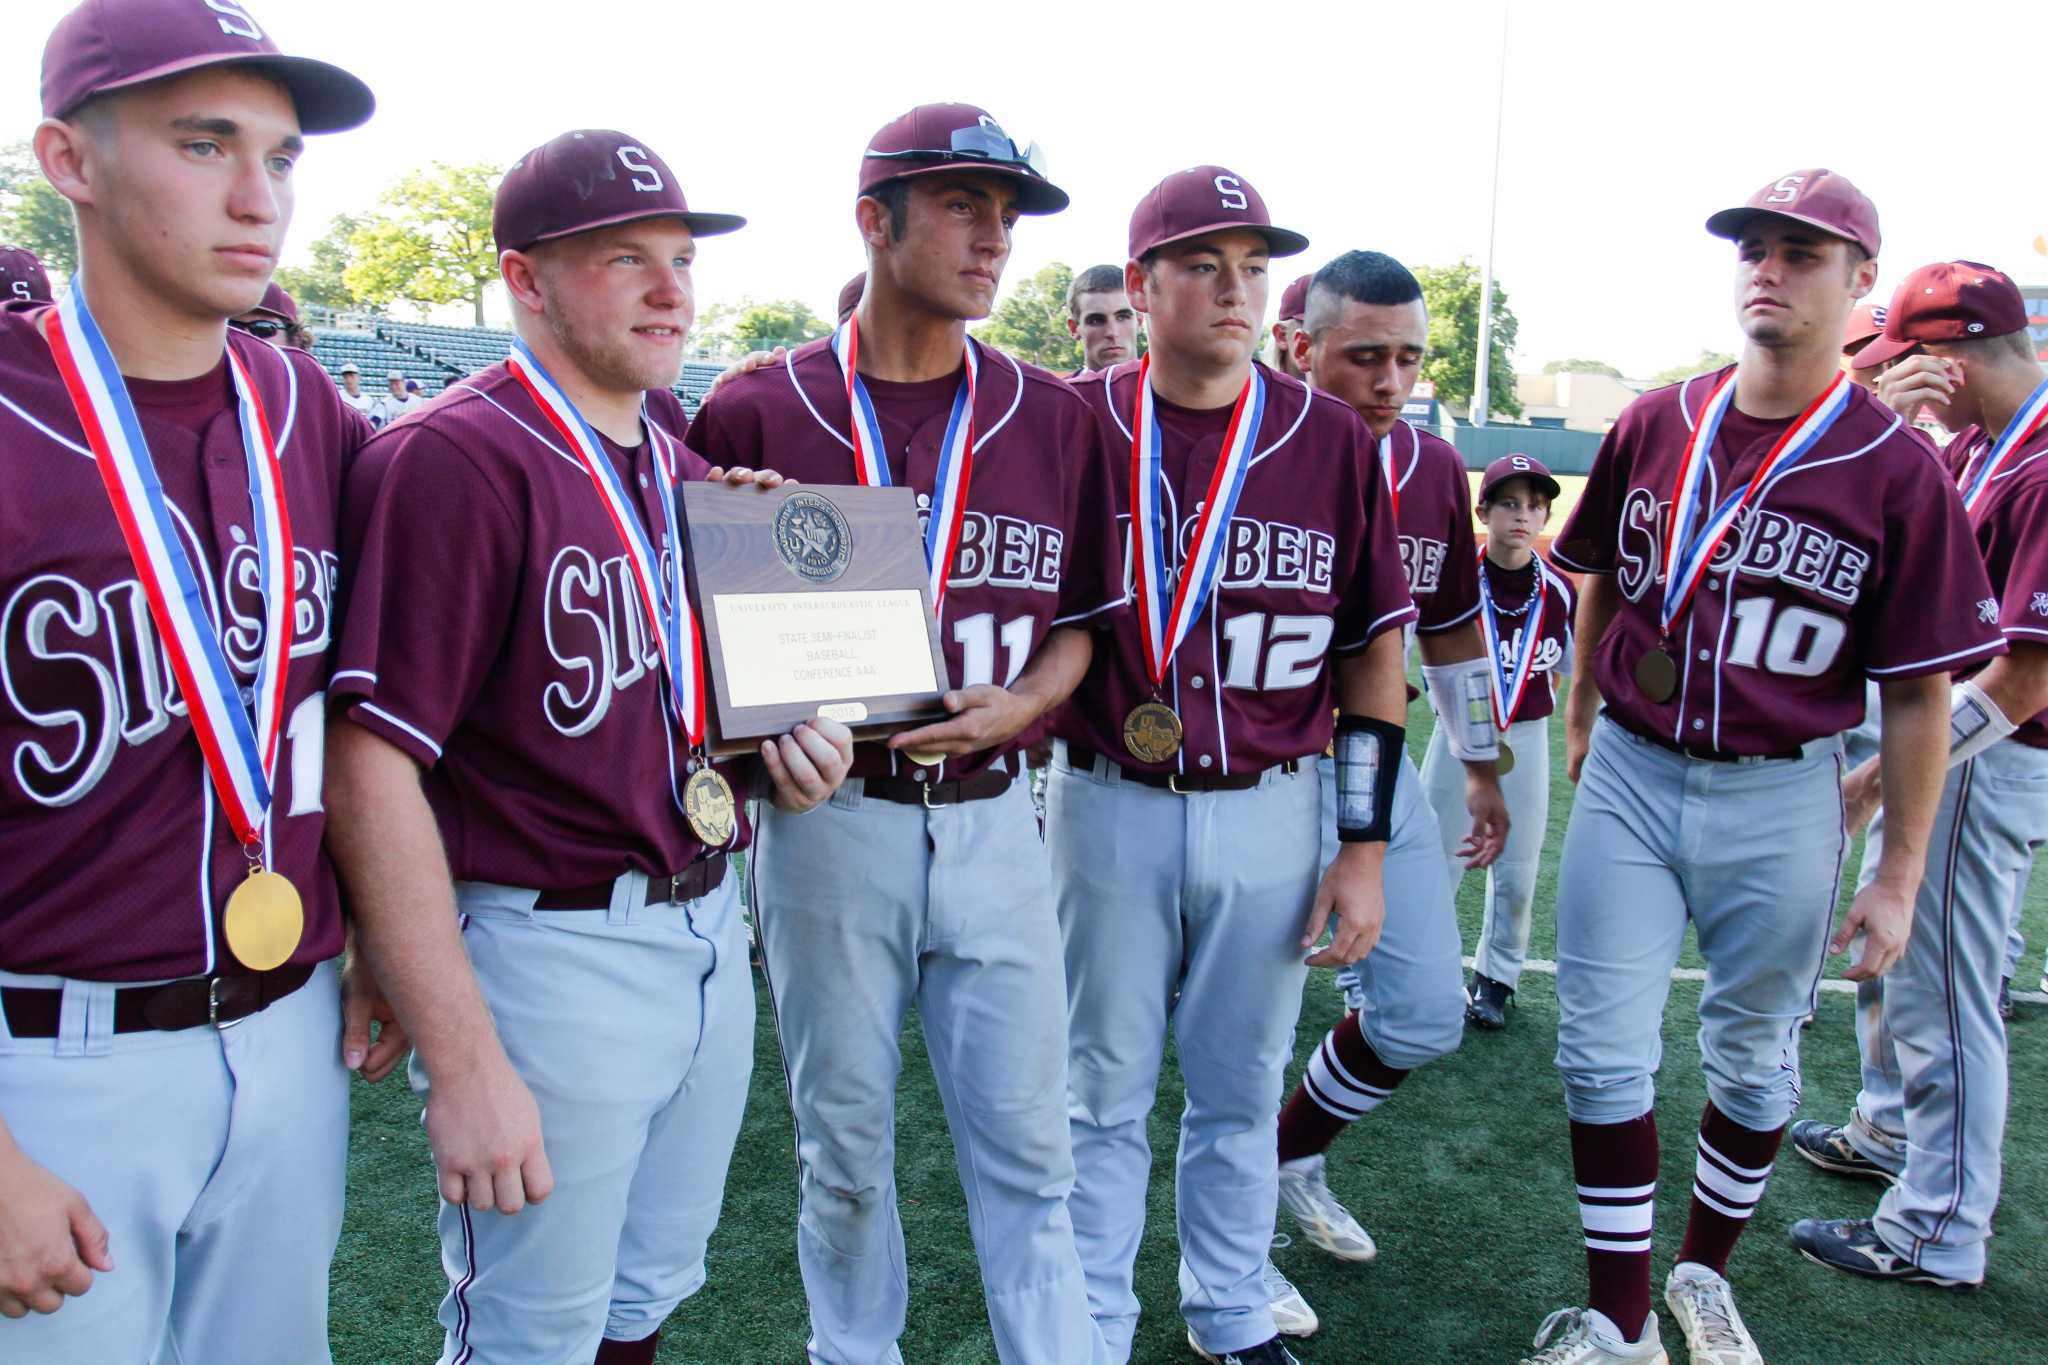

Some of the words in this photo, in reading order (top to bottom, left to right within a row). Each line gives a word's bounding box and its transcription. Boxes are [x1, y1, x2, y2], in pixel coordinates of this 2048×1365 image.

[204, 0, 262, 40] S
[616, 146, 663, 192] S
[1214, 175, 1248, 210] S
[1767, 176, 1805, 203] S
[12, 281, 31, 302] S
[1511, 456, 1530, 471] S
[777, 633, 808, 645] STATE
[809, 629, 877, 642] SEMI-FINALIST
[954, 613, 1034, 689] 11
[1223, 611, 1334, 691] 12
[1726, 596, 1847, 677] 10
[806, 648, 858, 662] BASEBALL
[792, 667, 852, 681] CONFERENCE
[856, 665, 877, 676] AAA
